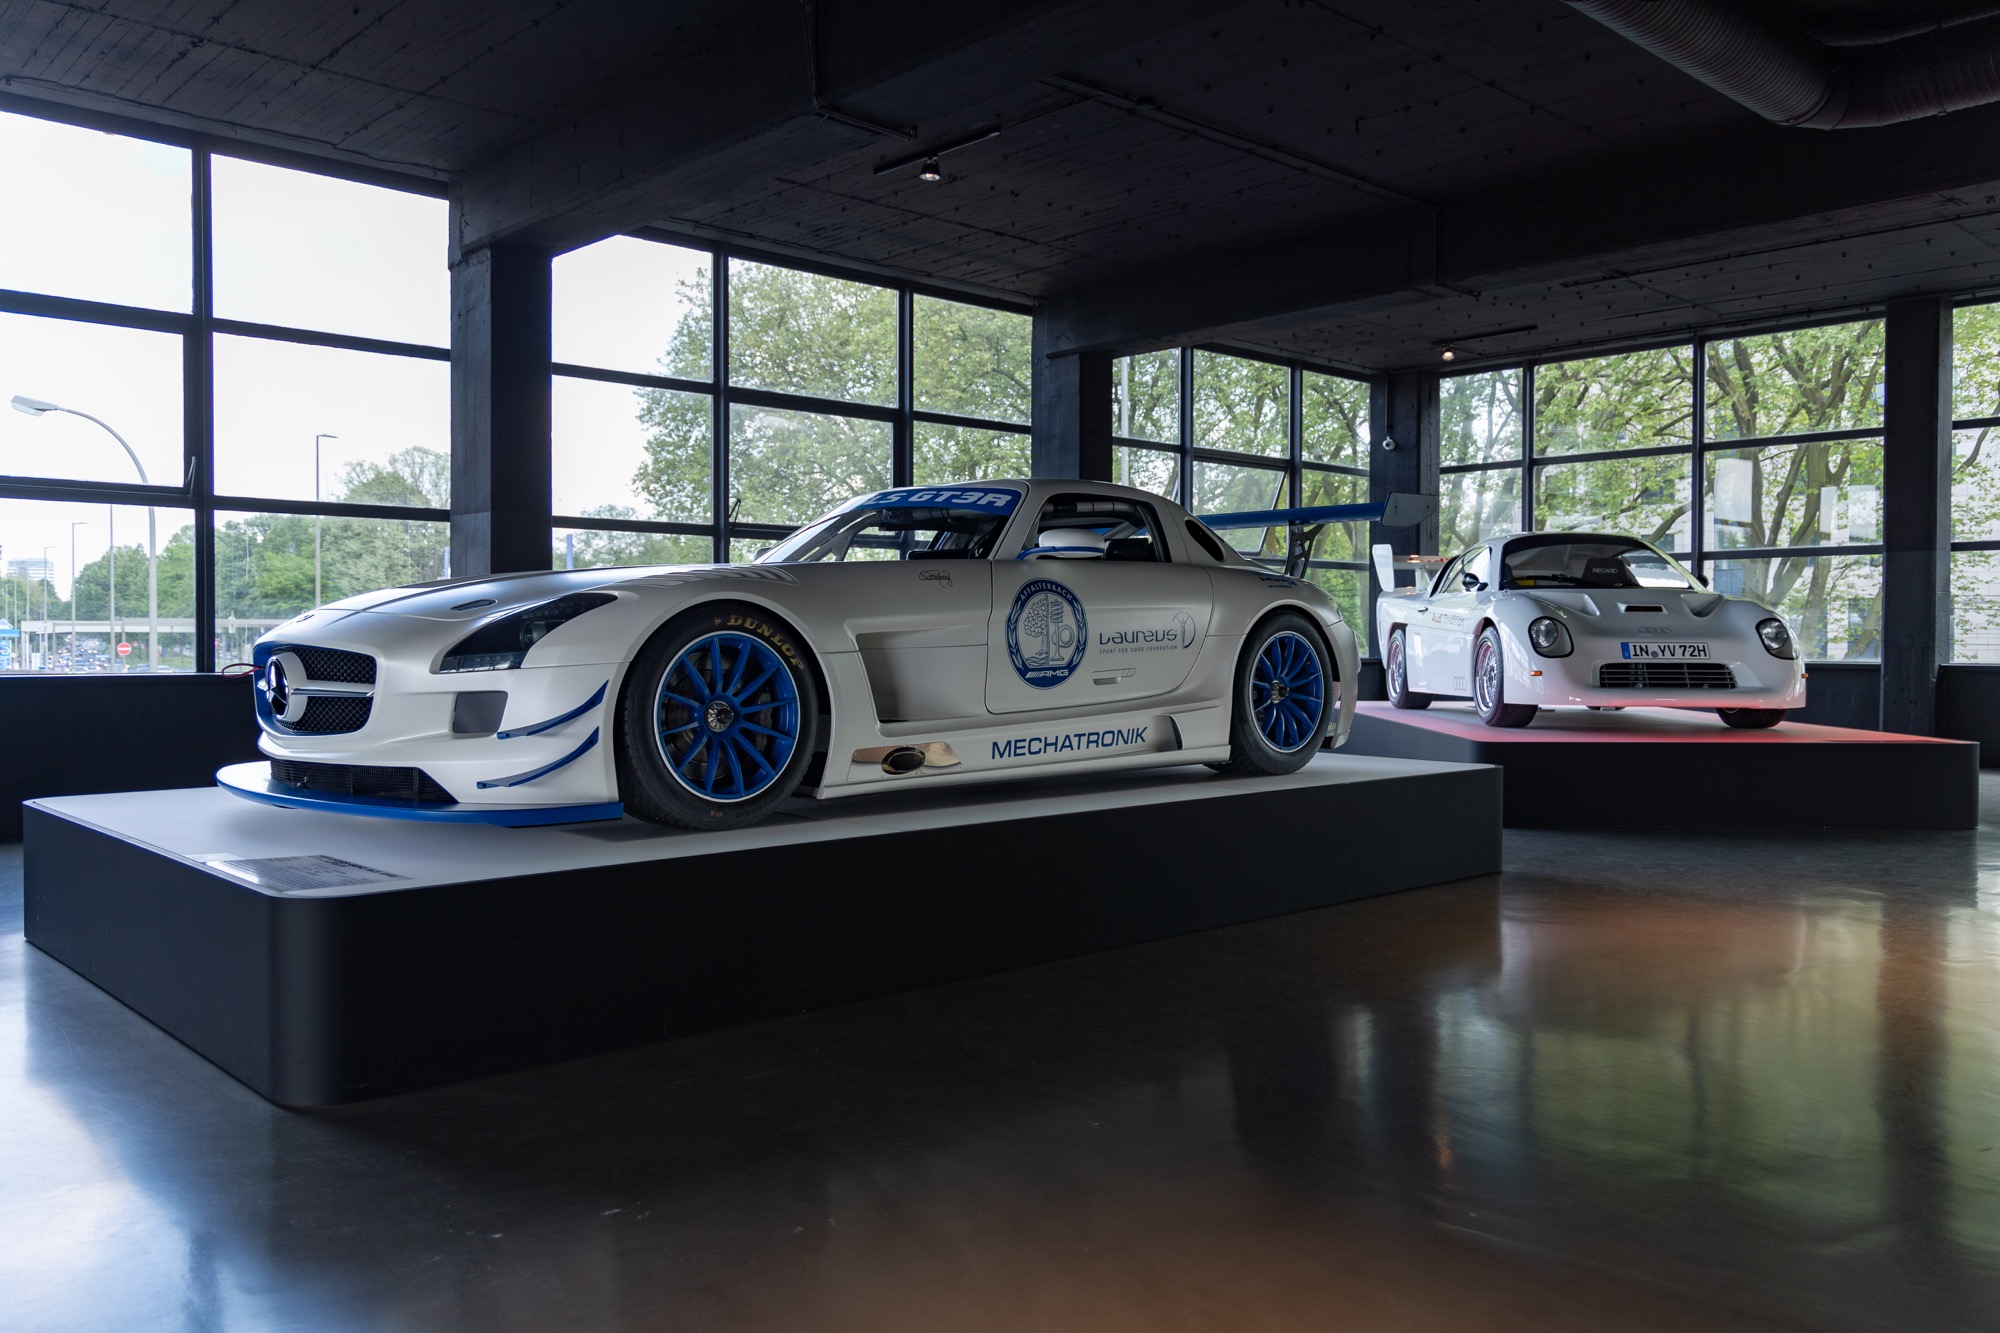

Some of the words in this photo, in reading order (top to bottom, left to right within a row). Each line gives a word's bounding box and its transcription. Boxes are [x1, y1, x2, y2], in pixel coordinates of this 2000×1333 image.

[908, 491, 1012, 507] GT3R
[1020, 582, 1073, 601] AFFALTERBACH
[727, 614, 804, 669] DUNLOP
[1632, 644, 1650, 657] IN
[1658, 644, 1676, 657] YV
[1679, 644, 1708, 657] 72H
[1040, 669, 1069, 677] AMG
[991, 726, 1149, 760] MECHATRONIK
